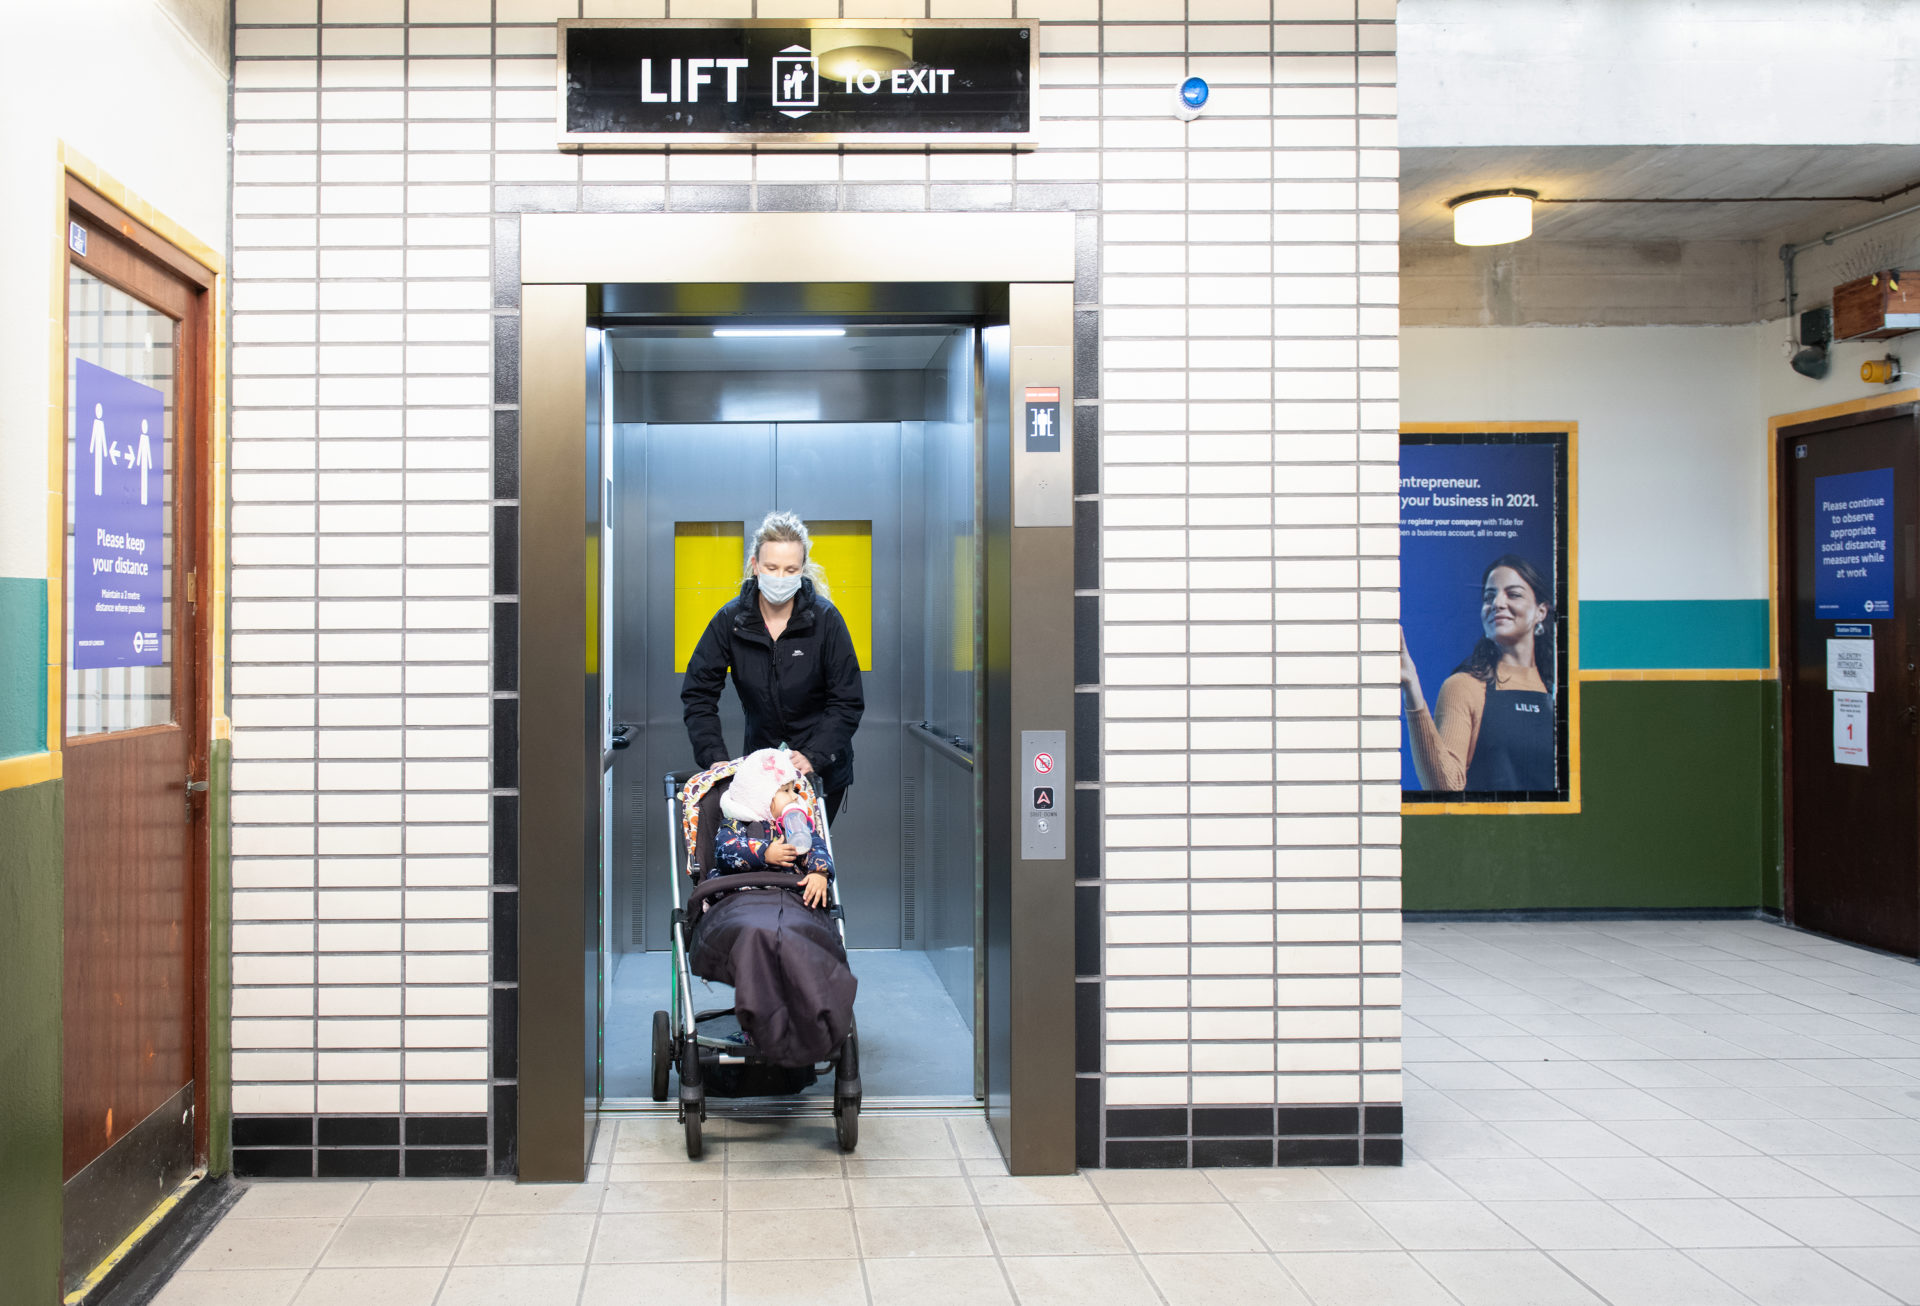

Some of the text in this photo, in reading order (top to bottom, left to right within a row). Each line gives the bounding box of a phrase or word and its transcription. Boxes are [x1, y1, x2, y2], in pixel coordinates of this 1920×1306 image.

[641, 58, 955, 102] LIFT TO EXIT
[1401, 493, 1539, 509] your business in 2021.
[1822, 497, 1885, 512] Please continue
[1408, 518, 1434, 526] register
[1435, 519, 1450, 527] your
[1451, 519, 1482, 527] company
[1483, 518, 1498, 526] with
[1498, 518, 1513, 526] Tide
[1513, 518, 1524, 526] for
[1832, 512, 1875, 524] to observe
[1417, 529, 1447, 537] business
[1447, 529, 1476, 538] account,
[1477, 529, 1486, 537] all
[1486, 529, 1493, 537] in
[1507, 531, 1518, 539] go.
[1830, 526, 1876, 540] appropriate
[97, 528, 146, 555] Please keep
[1821, 539, 1886, 552] social distancing
[1823, 552, 1885, 565] measures while
[92, 556, 149, 576] your distance
[1836, 567, 1868, 578] at work
[95, 602, 115, 612] distance
[1515, 703, 1540, 713] LILI'S
[1846, 723, 1853, 740] 1
